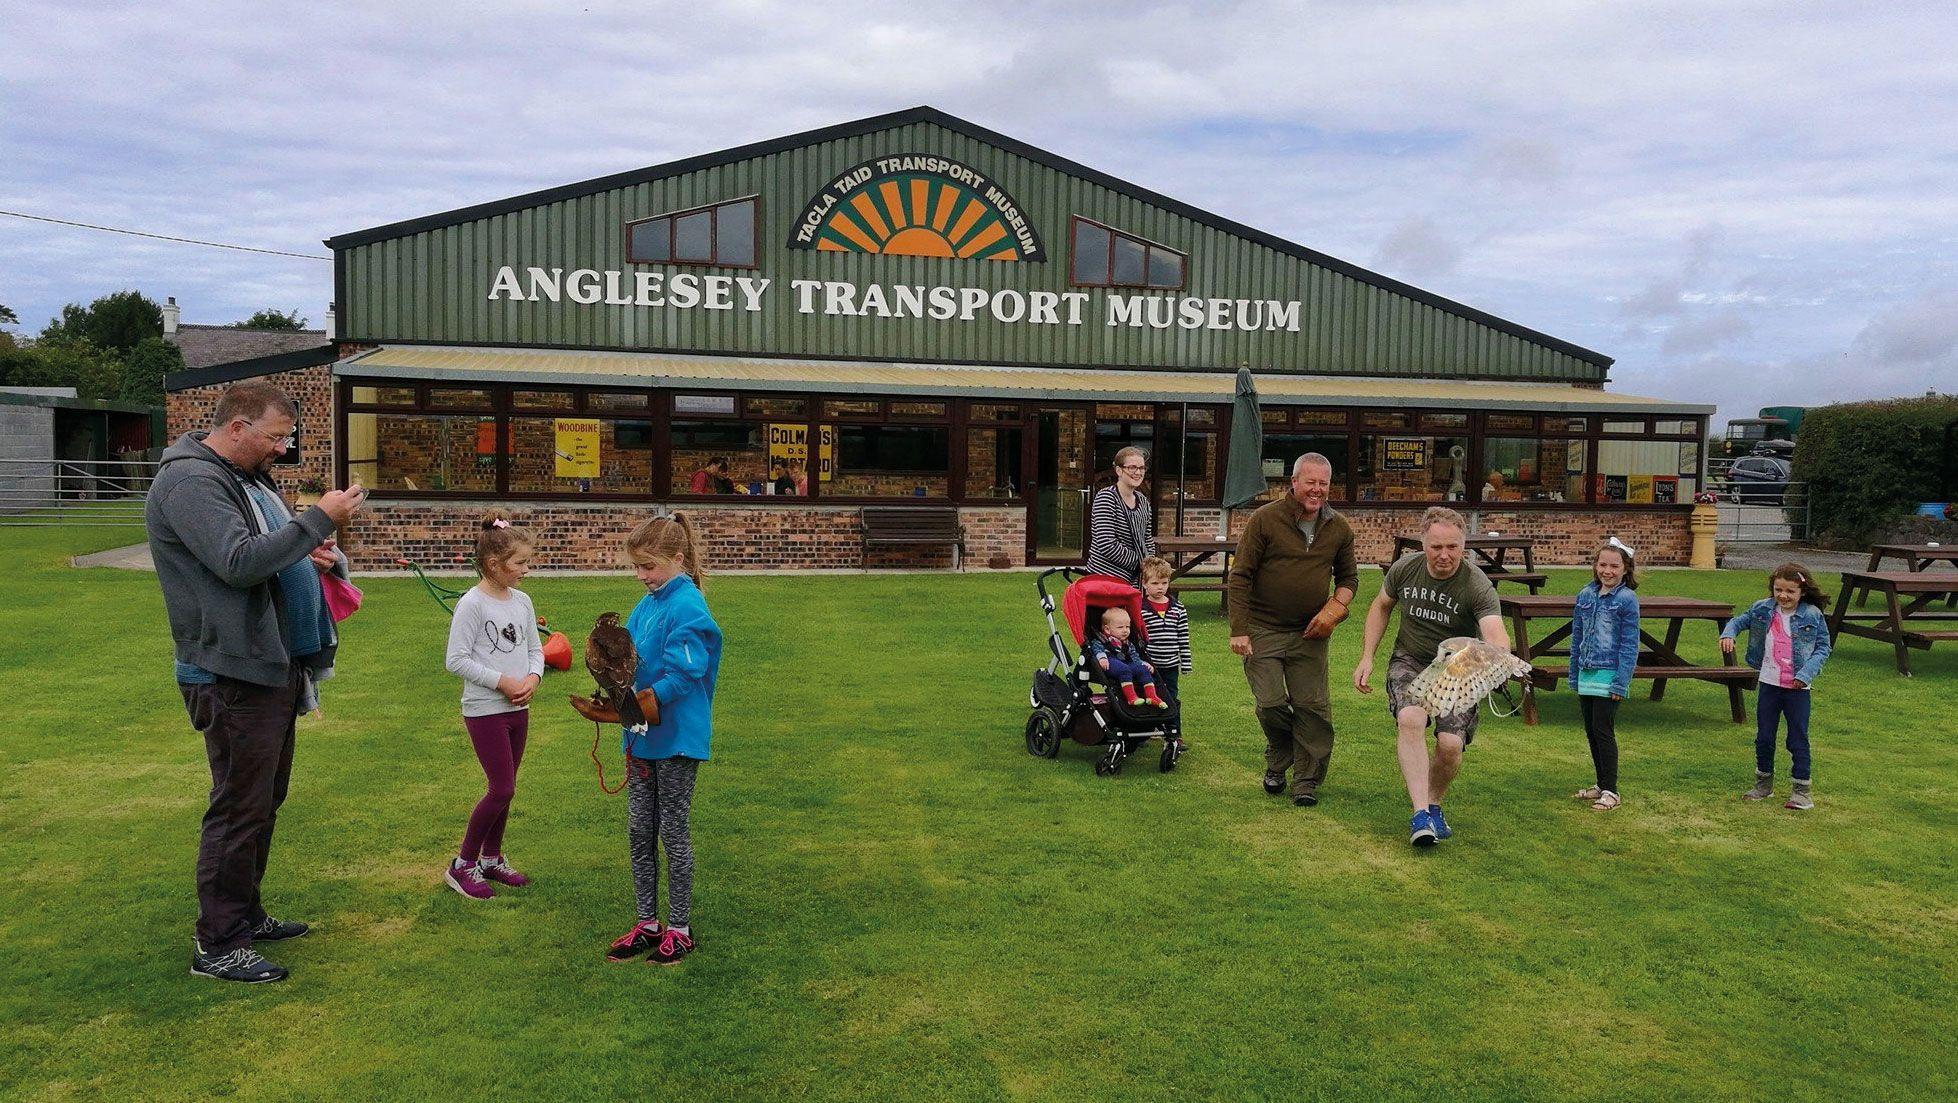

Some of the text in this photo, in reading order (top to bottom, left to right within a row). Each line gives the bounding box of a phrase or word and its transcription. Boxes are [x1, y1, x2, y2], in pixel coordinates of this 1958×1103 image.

[797, 156, 1036, 255] TACLA TAID TRANSPORT MUSEUM
[488, 266, 1302, 332] ANGLESEY TRANSPORT MUSEUM
[557, 422, 598, 433] WOODBINE
[770, 427, 831, 446] COLM'S
[1387, 451, 1415, 460] POWDERS
[1404, 587, 1460, 614] FARRELL
[1409, 605, 1451, 624] LONDON
